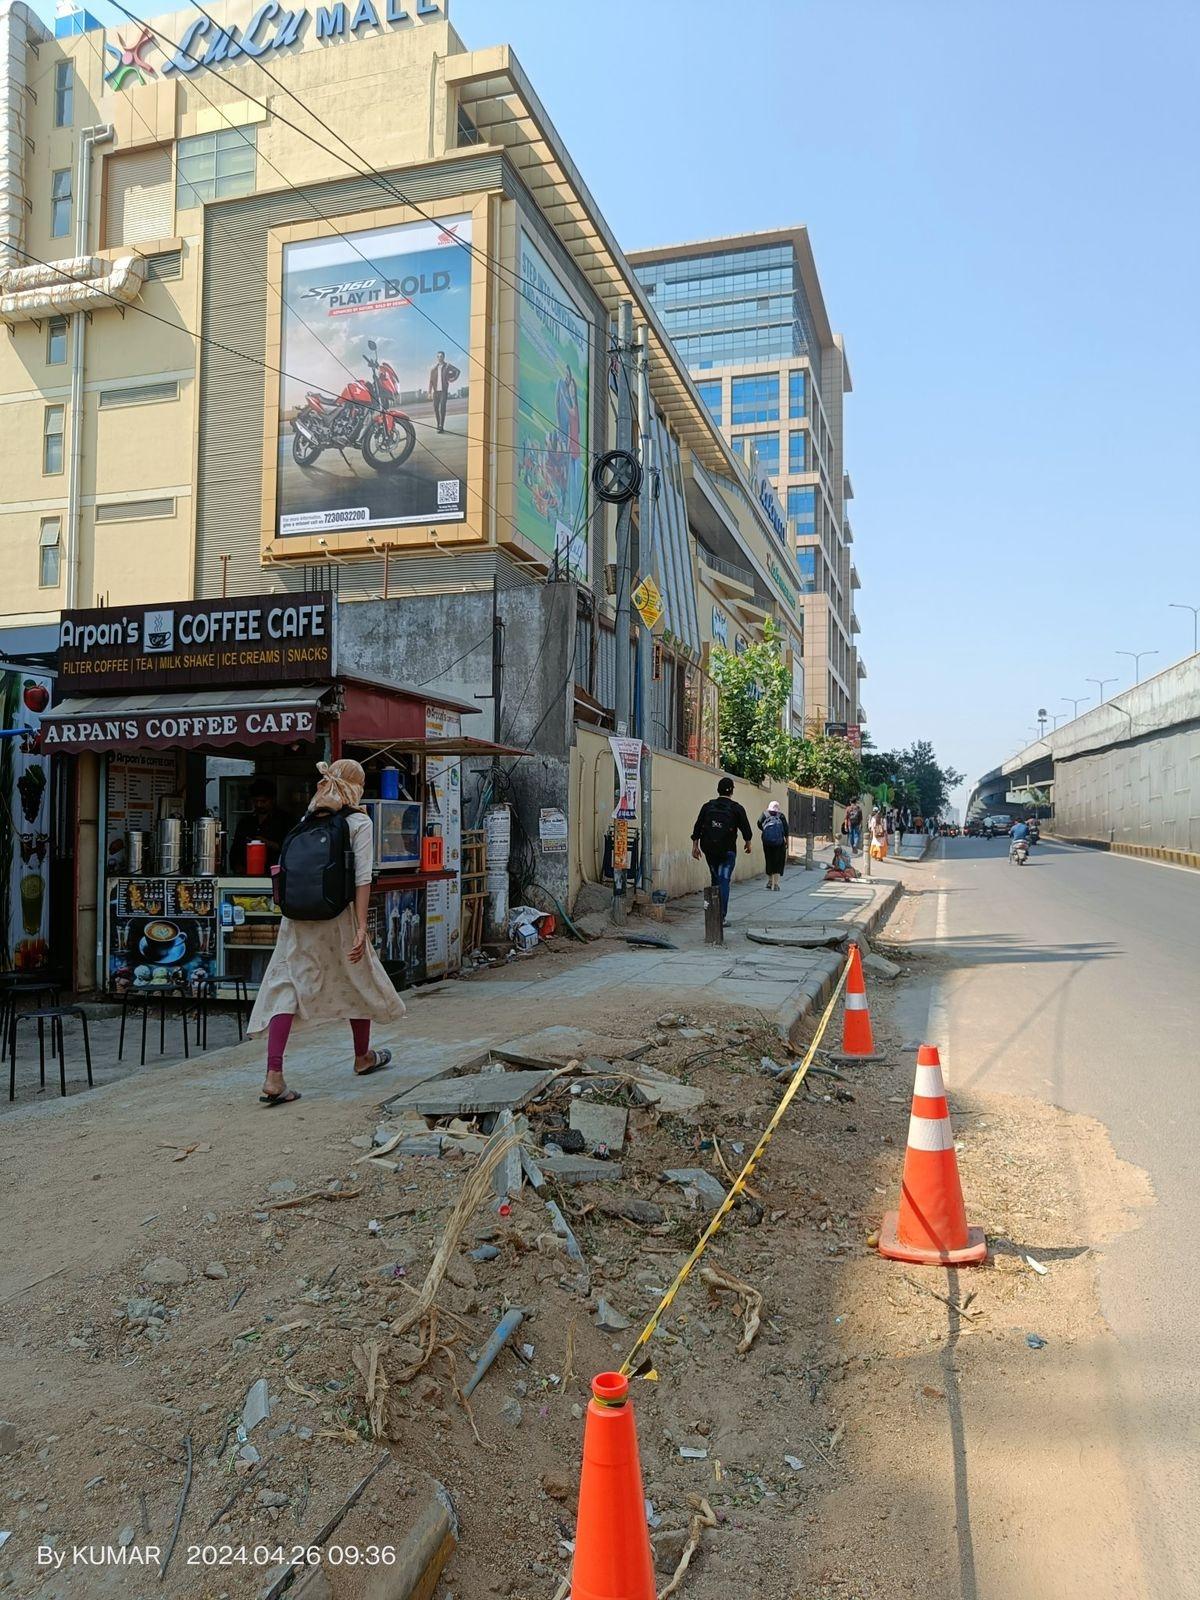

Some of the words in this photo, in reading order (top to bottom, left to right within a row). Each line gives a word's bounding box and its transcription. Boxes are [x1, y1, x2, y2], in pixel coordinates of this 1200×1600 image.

[161, 0, 306, 72] LuLu
[522, 252, 537, 283] STEP
[330, 292, 366, 307] PLAY
[368, 289, 382, 302] IT
[60, 616, 139, 653] Arpan's
[178, 609, 262, 645] COFFEE
[267, 604, 326, 639] CAFE
[63, 661, 92, 674] FILTER
[94, 659, 129, 673] COFFEE
[136, 657, 153, 671] TEA
[160, 655, 181, 669] MILK
[183, 653, 215, 668] SHAKE
[222, 652, 237, 666] ICE
[240, 649, 280, 665] CREAMS
[288, 647, 328, 663] SNACKS
[44, 720, 139, 743] ARPAN'S
[145, 715, 238, 739] COFFEE
[245, 711, 313, 733] CAFE
[117, 752, 145, 764] Arpan's
